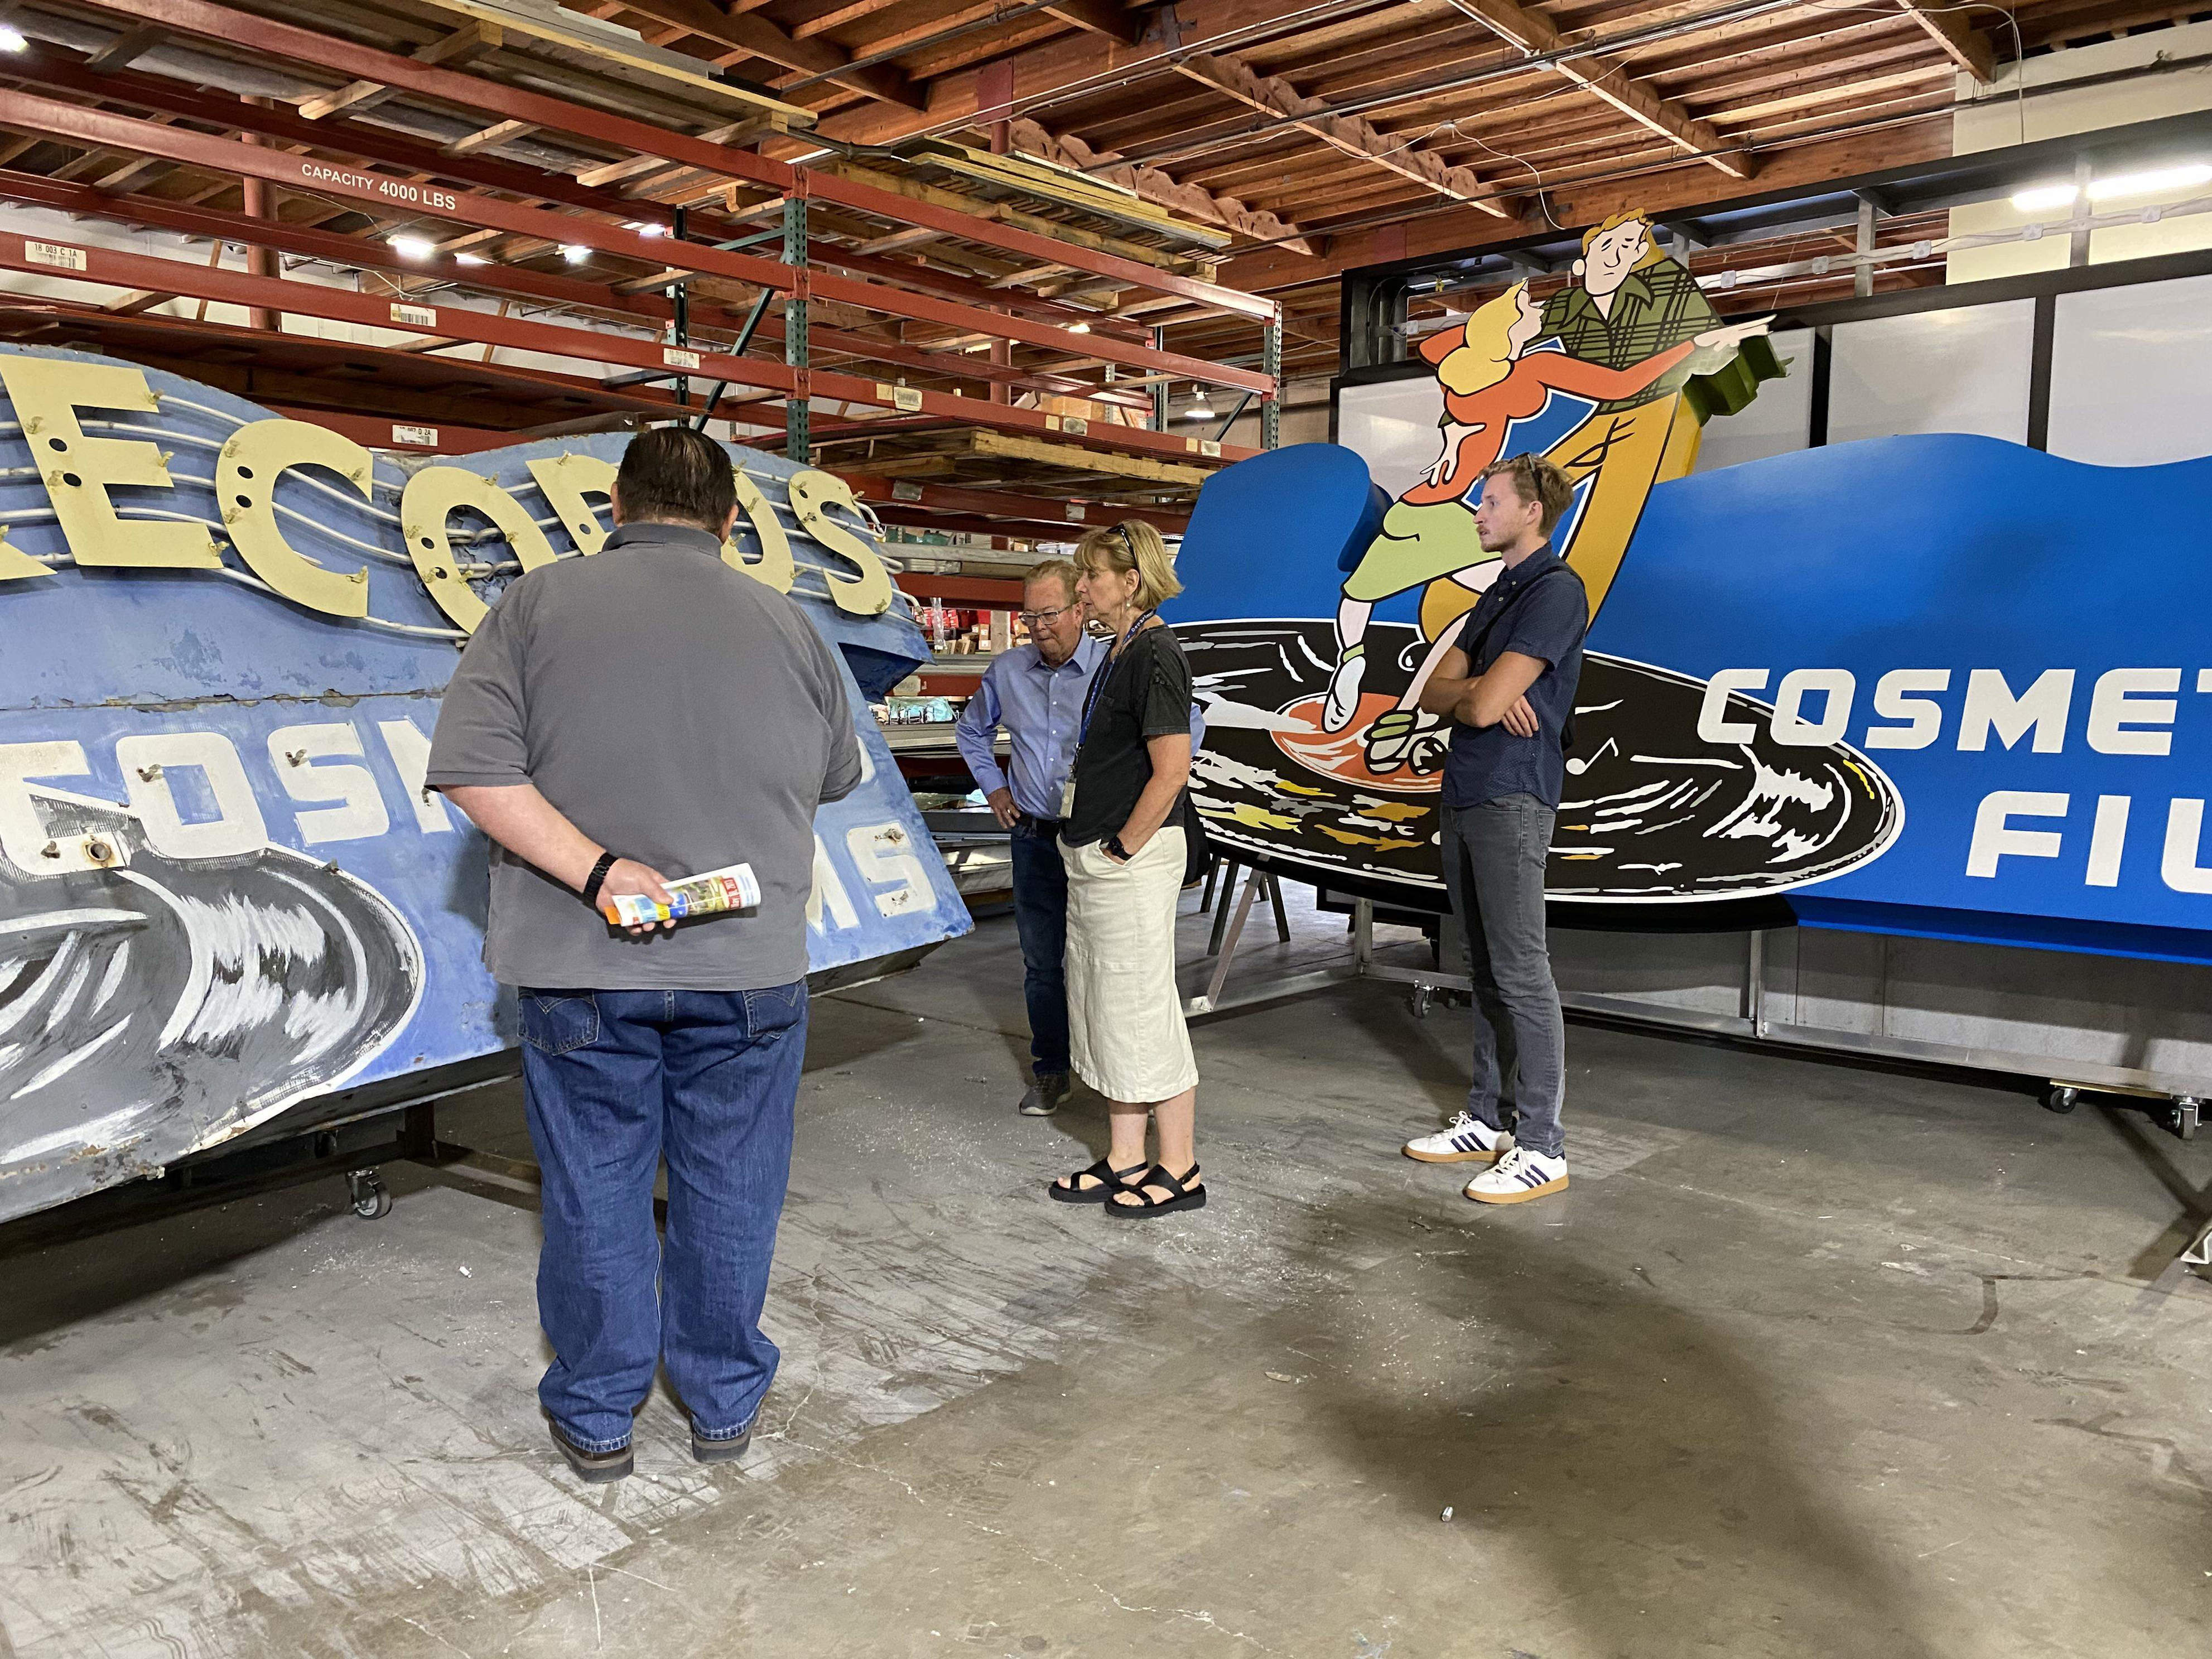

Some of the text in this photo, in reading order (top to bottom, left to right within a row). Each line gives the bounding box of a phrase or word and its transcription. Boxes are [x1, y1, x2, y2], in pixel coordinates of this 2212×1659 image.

[302, 163, 456, 210] CAPACITY 4000 LBS
[46, 245, 57, 254] 003
[0, 354, 893, 634] ECOS
